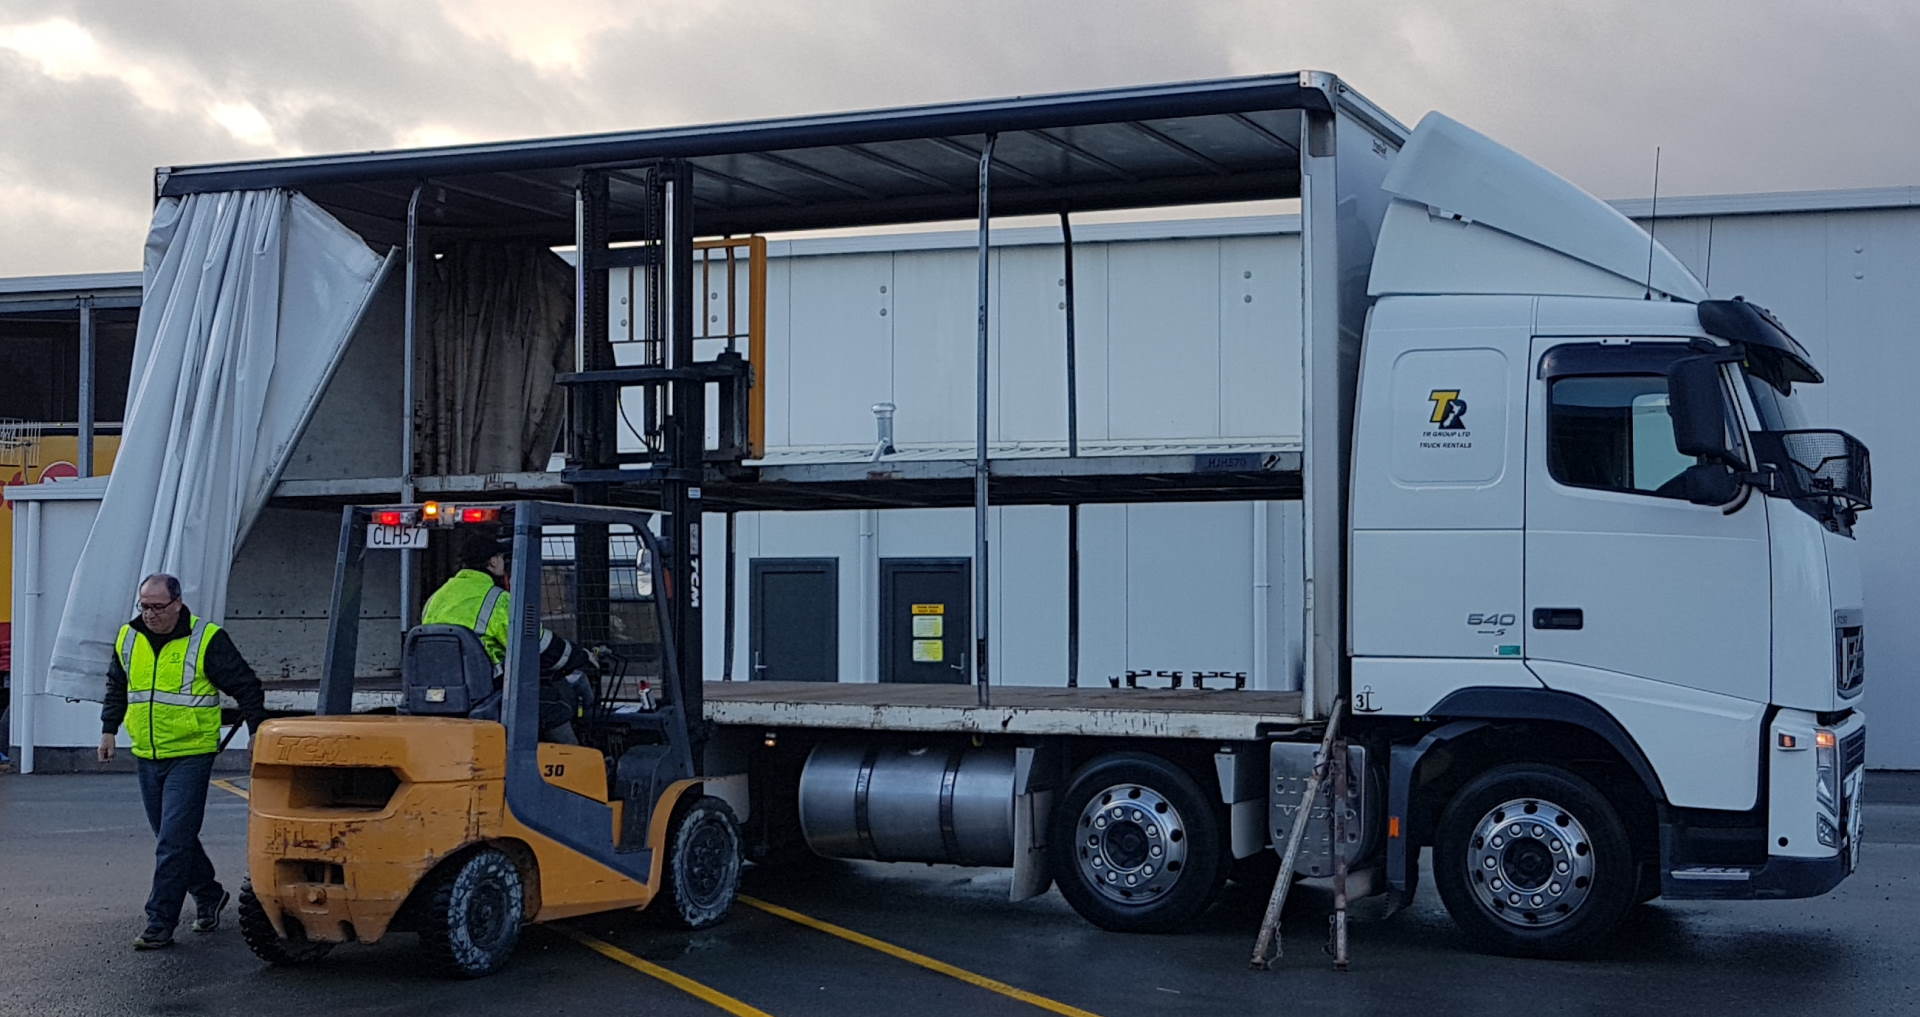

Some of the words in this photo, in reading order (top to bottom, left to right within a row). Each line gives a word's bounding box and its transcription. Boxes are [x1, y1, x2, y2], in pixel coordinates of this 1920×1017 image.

[1428, 389, 1467, 430] TR
[373, 525, 422, 545] CLH57
[690, 558, 700, 608] TCM
[543, 764, 565, 777] 30
